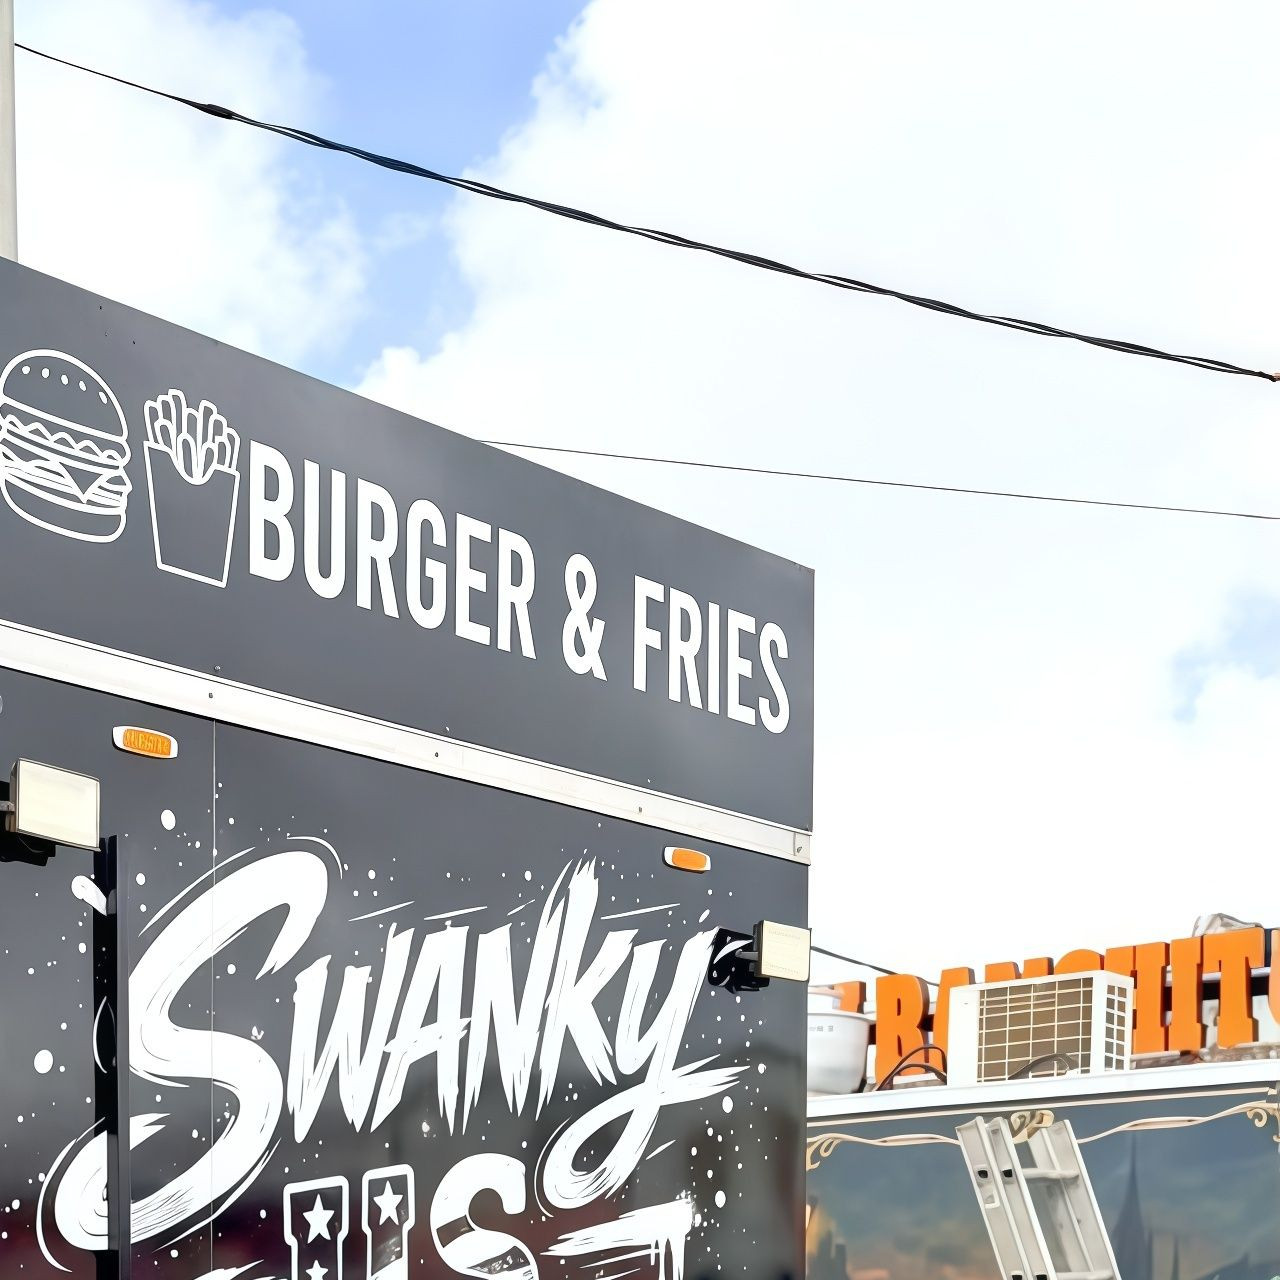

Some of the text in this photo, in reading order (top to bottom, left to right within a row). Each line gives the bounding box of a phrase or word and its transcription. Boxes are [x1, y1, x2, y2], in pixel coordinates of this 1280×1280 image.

[249, 439, 790, 734] BURGER & FRIES
